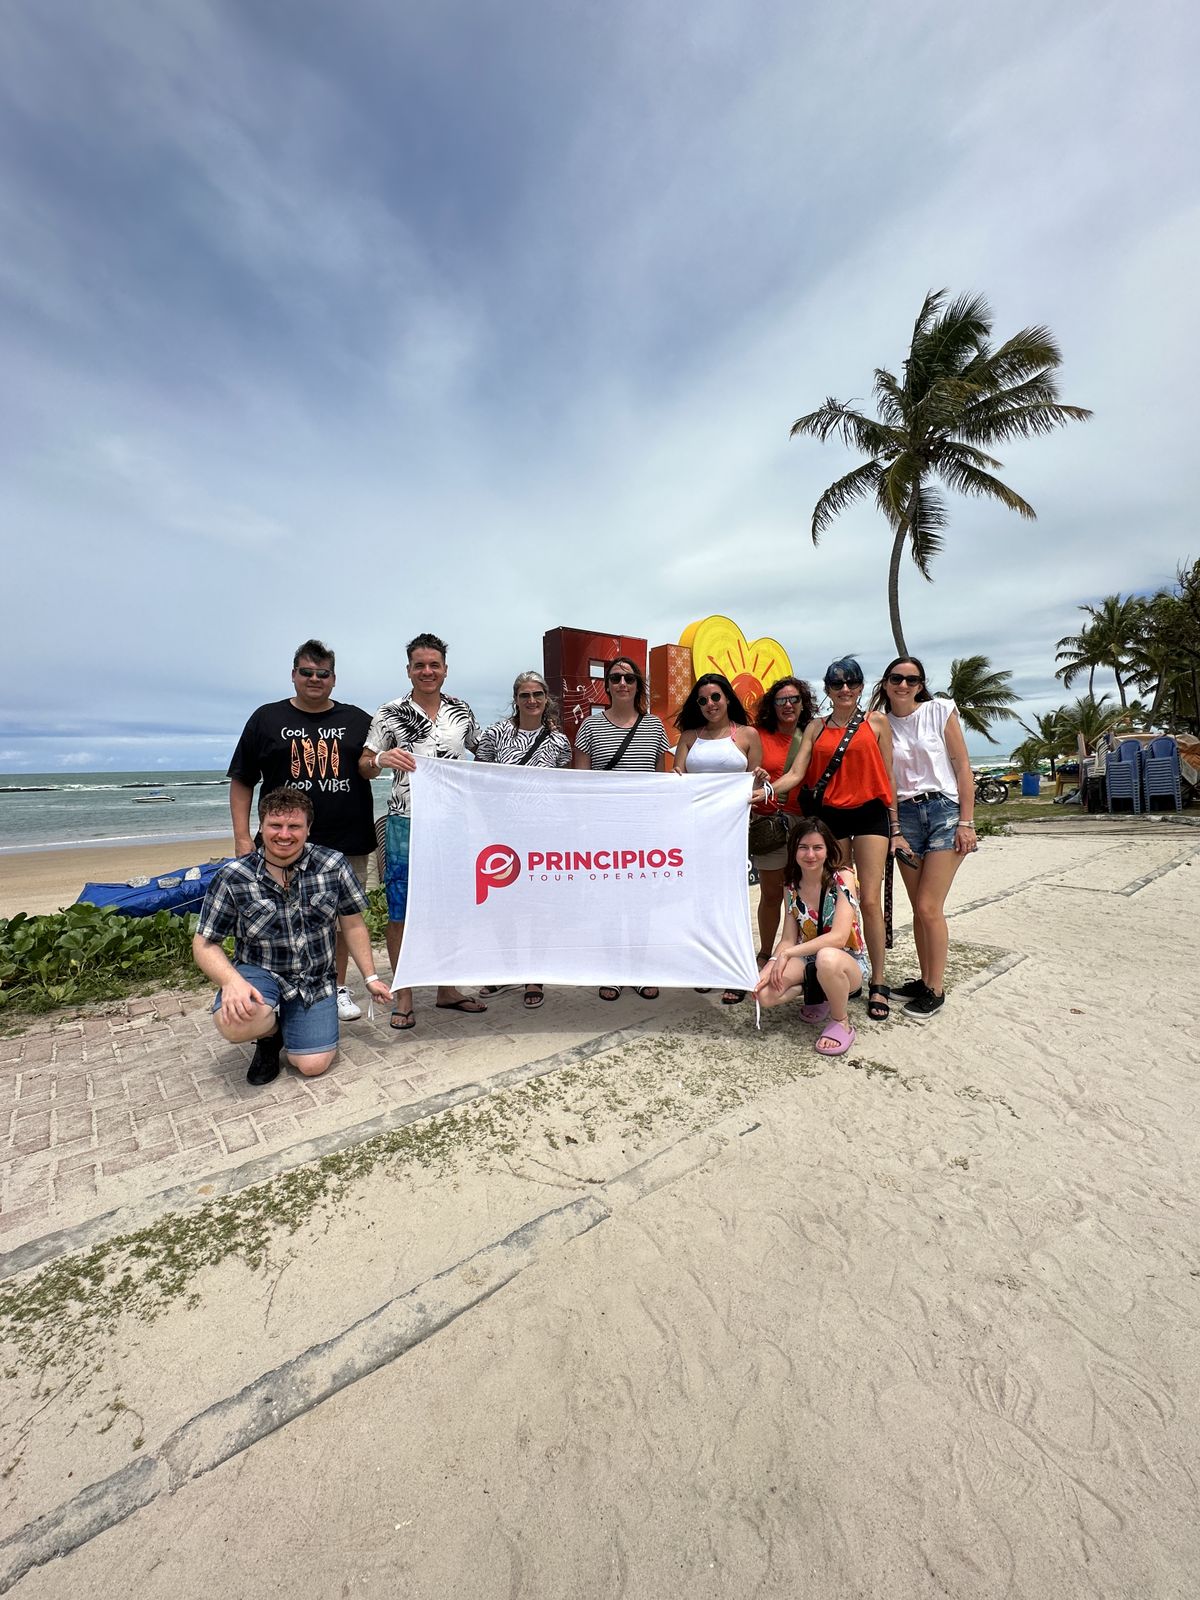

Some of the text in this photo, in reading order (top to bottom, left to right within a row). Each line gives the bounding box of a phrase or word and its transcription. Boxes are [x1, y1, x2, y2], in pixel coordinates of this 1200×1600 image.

[281, 727, 347, 740] COOL SURF
[318, 778, 351, 793] VIBES
[528, 848, 684, 871] PRINCIPIOS
[529, 870, 684, 882] TOUR OPERATOR
